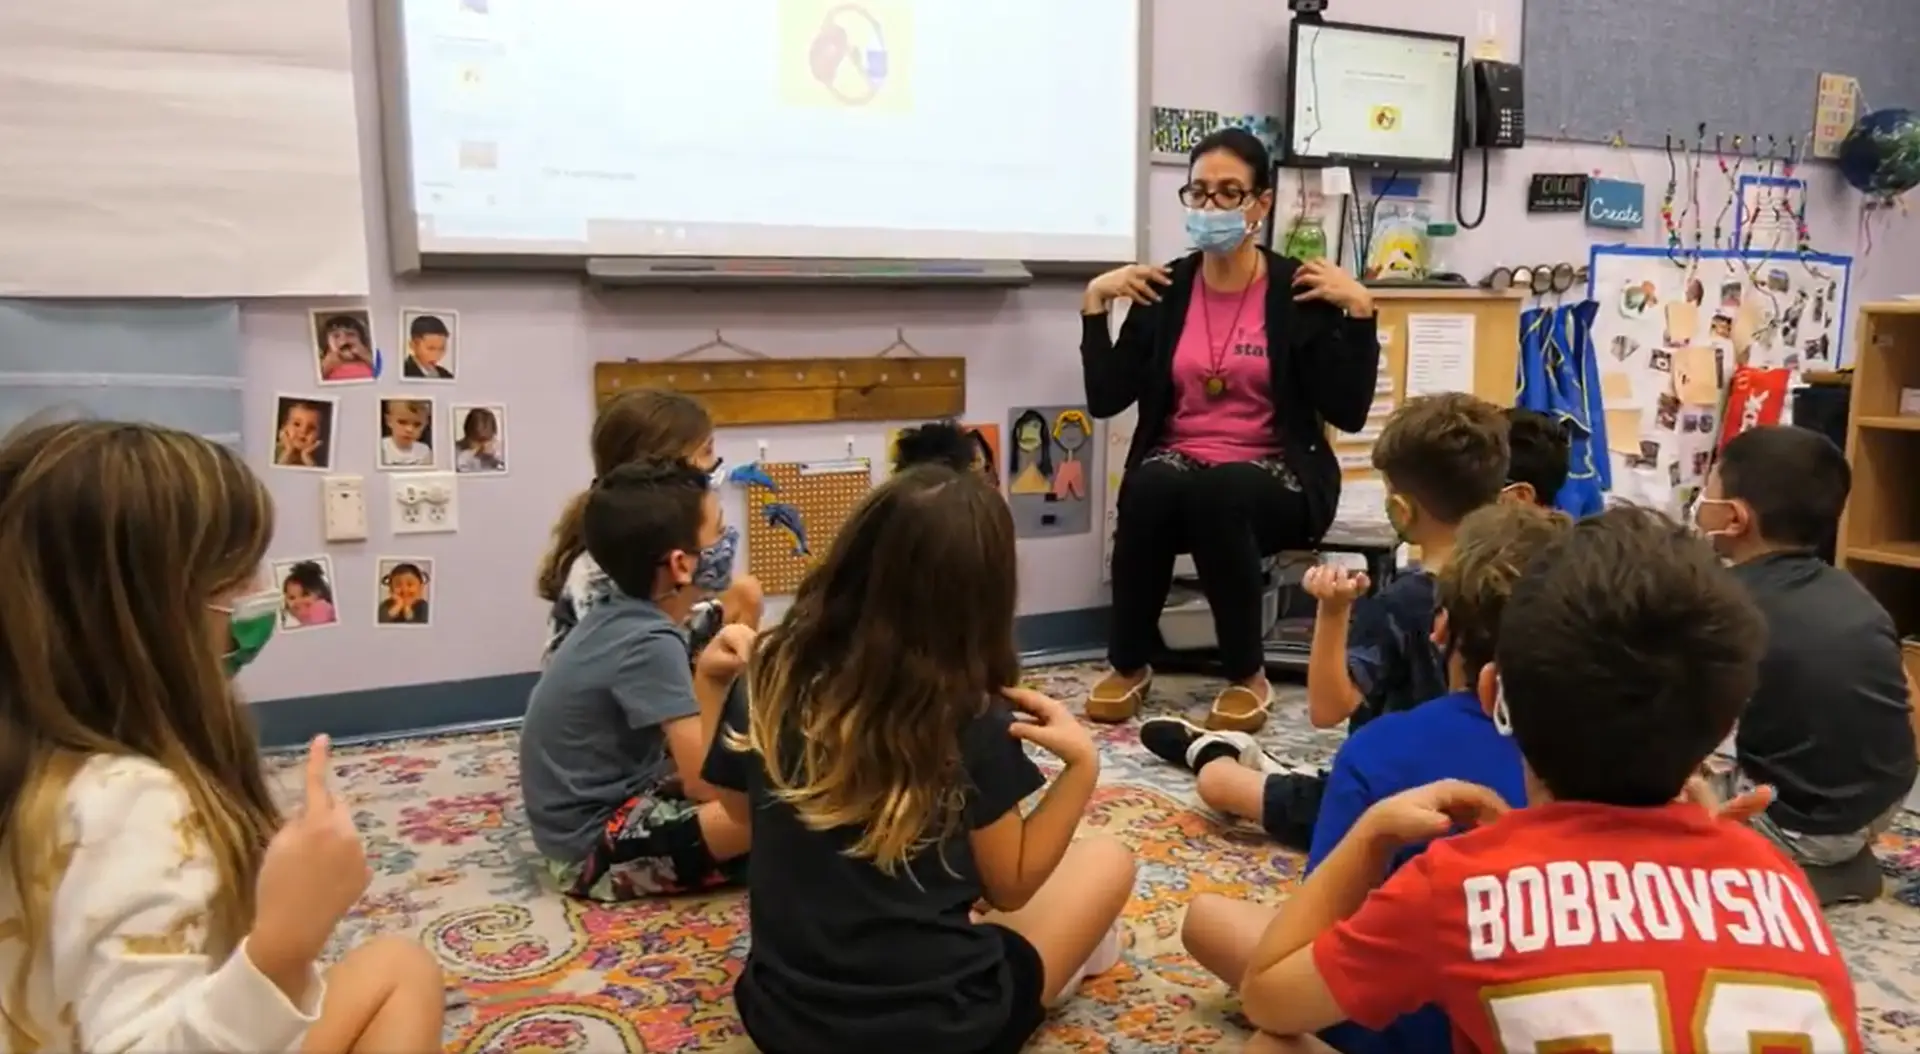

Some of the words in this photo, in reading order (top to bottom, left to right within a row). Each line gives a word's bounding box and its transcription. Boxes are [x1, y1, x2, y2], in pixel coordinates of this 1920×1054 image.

[1590, 197, 1643, 223] Create
[1234, 343, 1267, 357] sta
[1464, 860, 1830, 960] BOBROVSKY
